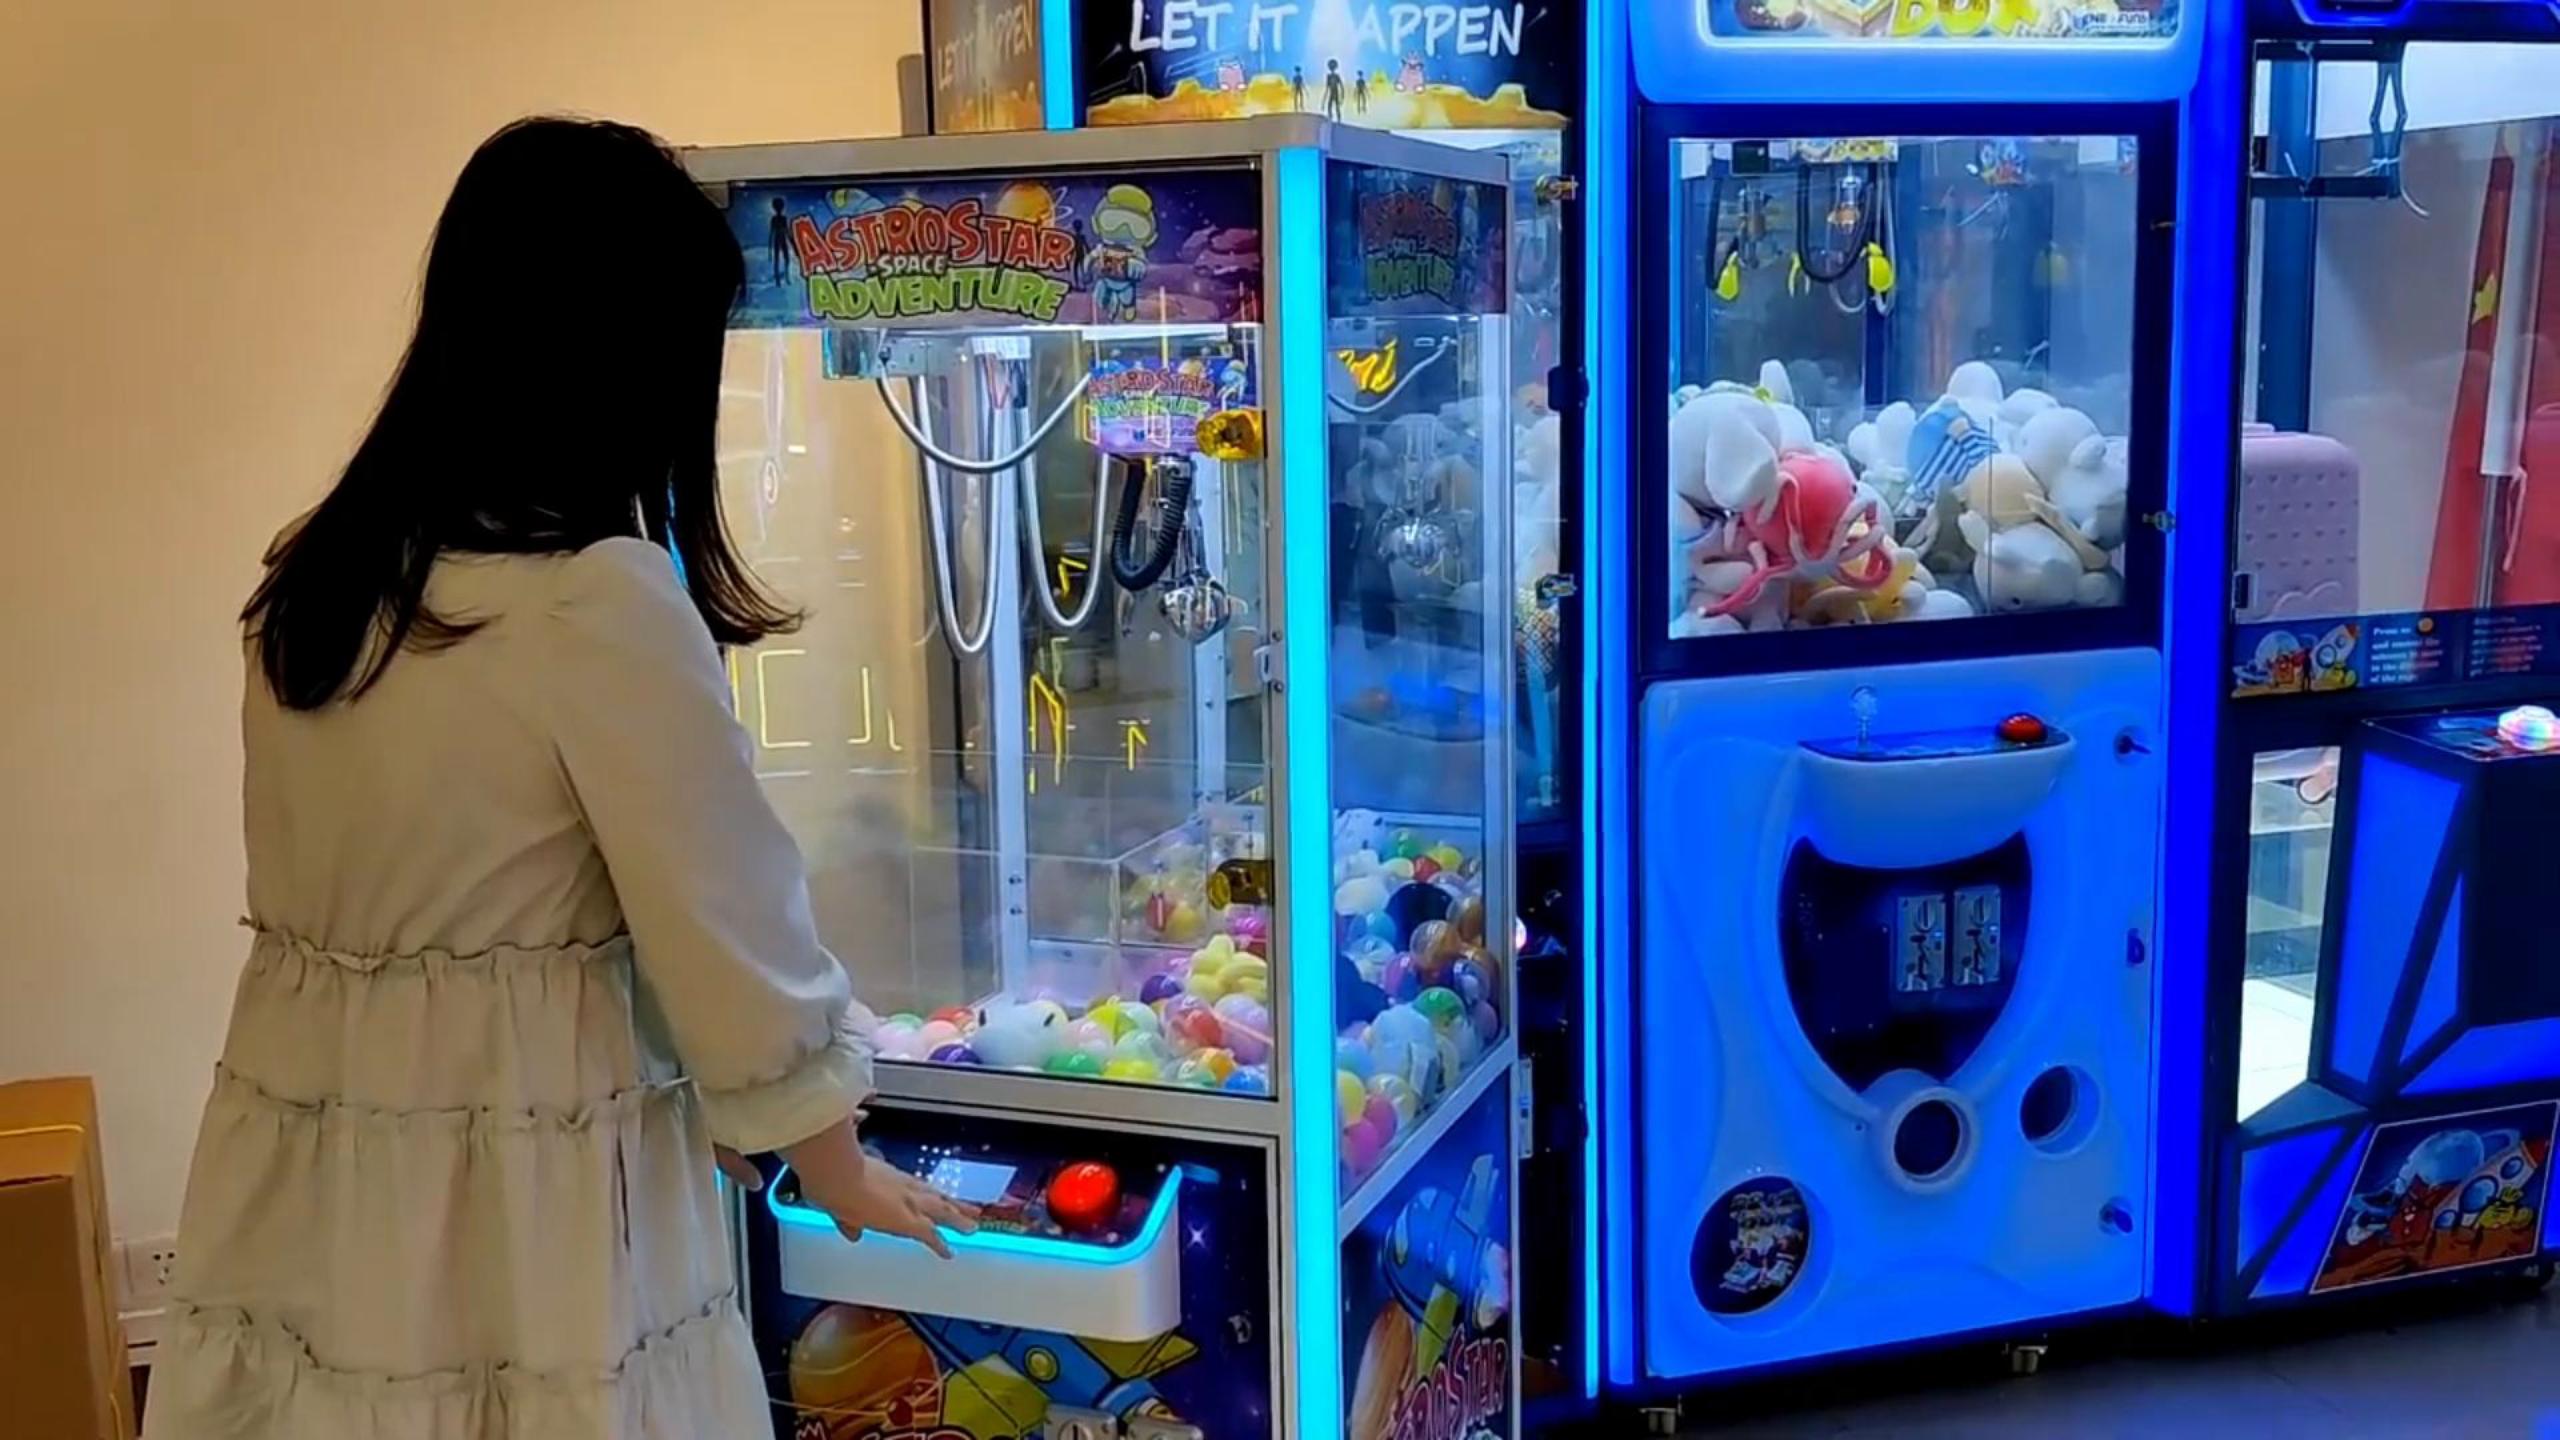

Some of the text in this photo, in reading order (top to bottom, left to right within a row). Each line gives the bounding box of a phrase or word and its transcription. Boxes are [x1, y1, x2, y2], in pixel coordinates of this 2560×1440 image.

[1129, 0, 1524, 57] LET IT APPEN
[792, 200, 1076, 274] ASTROSTAR
[876, 254, 946, 276] SPACE
[808, 267, 1070, 320] ADVENTURE
